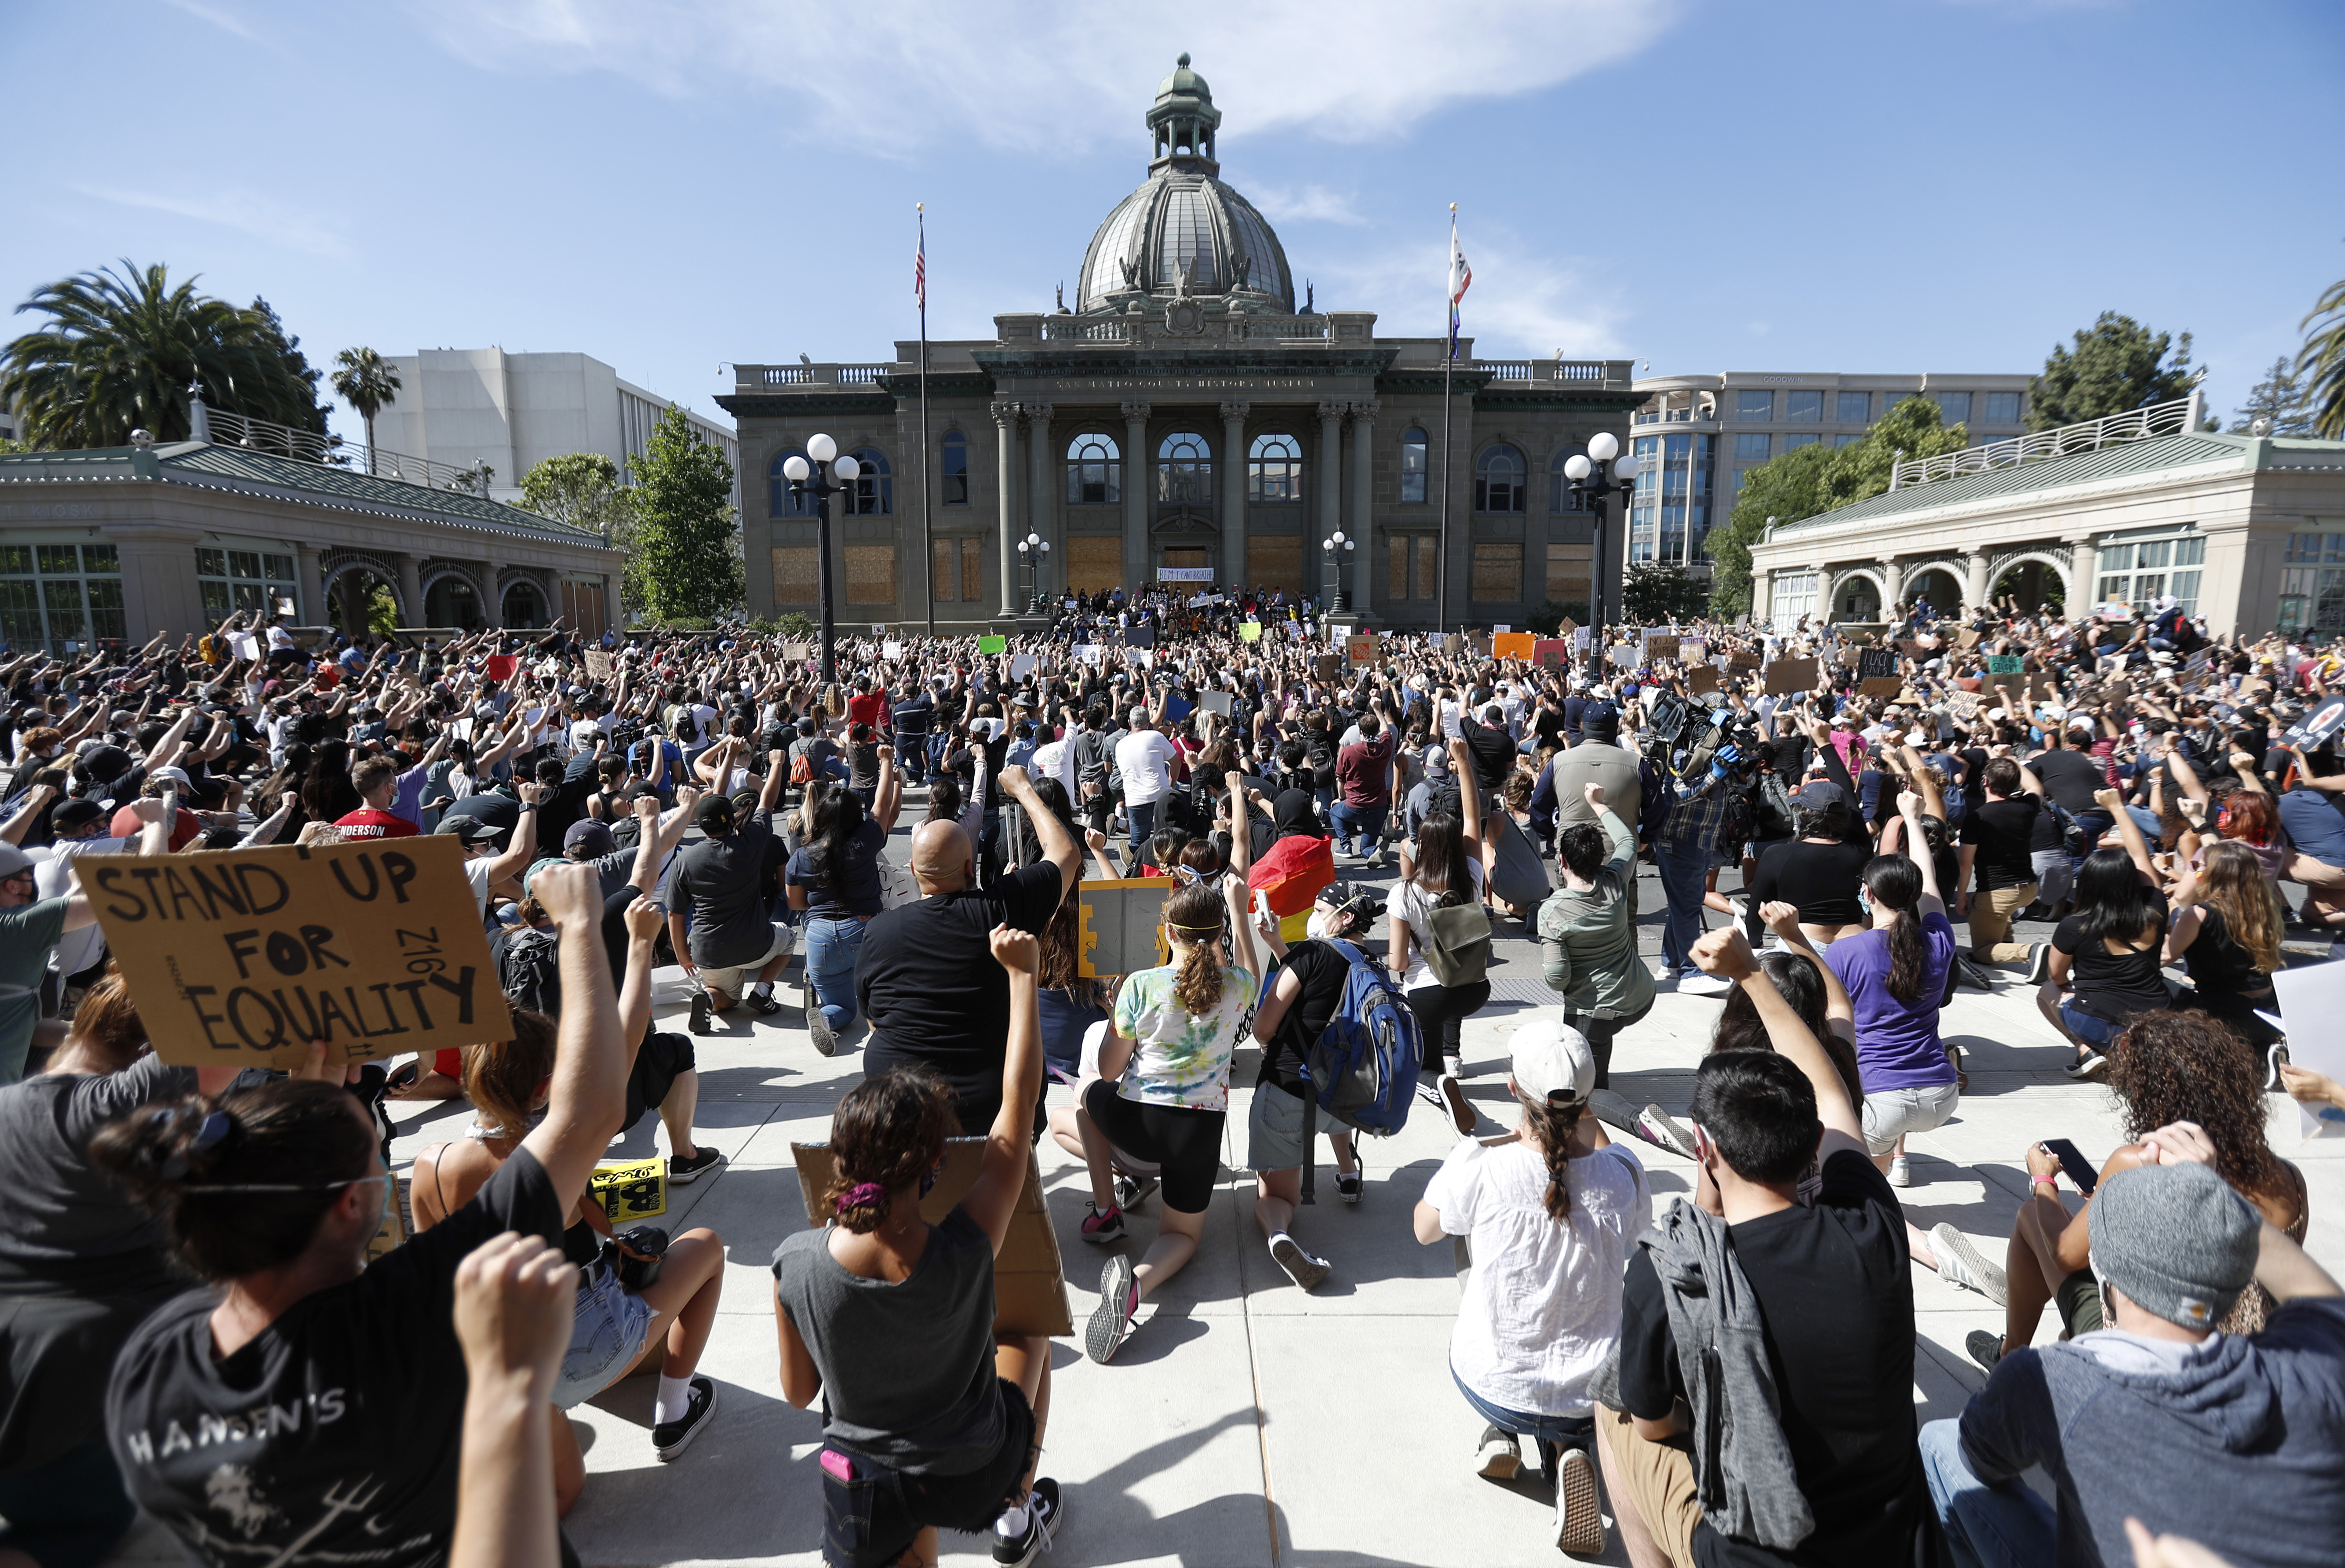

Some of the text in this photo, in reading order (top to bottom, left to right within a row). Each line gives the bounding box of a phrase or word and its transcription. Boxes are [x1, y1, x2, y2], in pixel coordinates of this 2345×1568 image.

[1160, 570, 1213, 579] BLM I CANT BREATHE
[1577, 629, 1590, 639] BLA
[1650, 636, 1662, 646] NO
[1649, 647, 1662, 656] NO
[590, 658, 604, 666] POLICE
[96, 851, 417, 922] STAND UP
[223, 924, 350, 979] FOR
[187, 966, 476, 1051] EQUALITY
[128, 1388, 346, 1463] HANSEN'S
